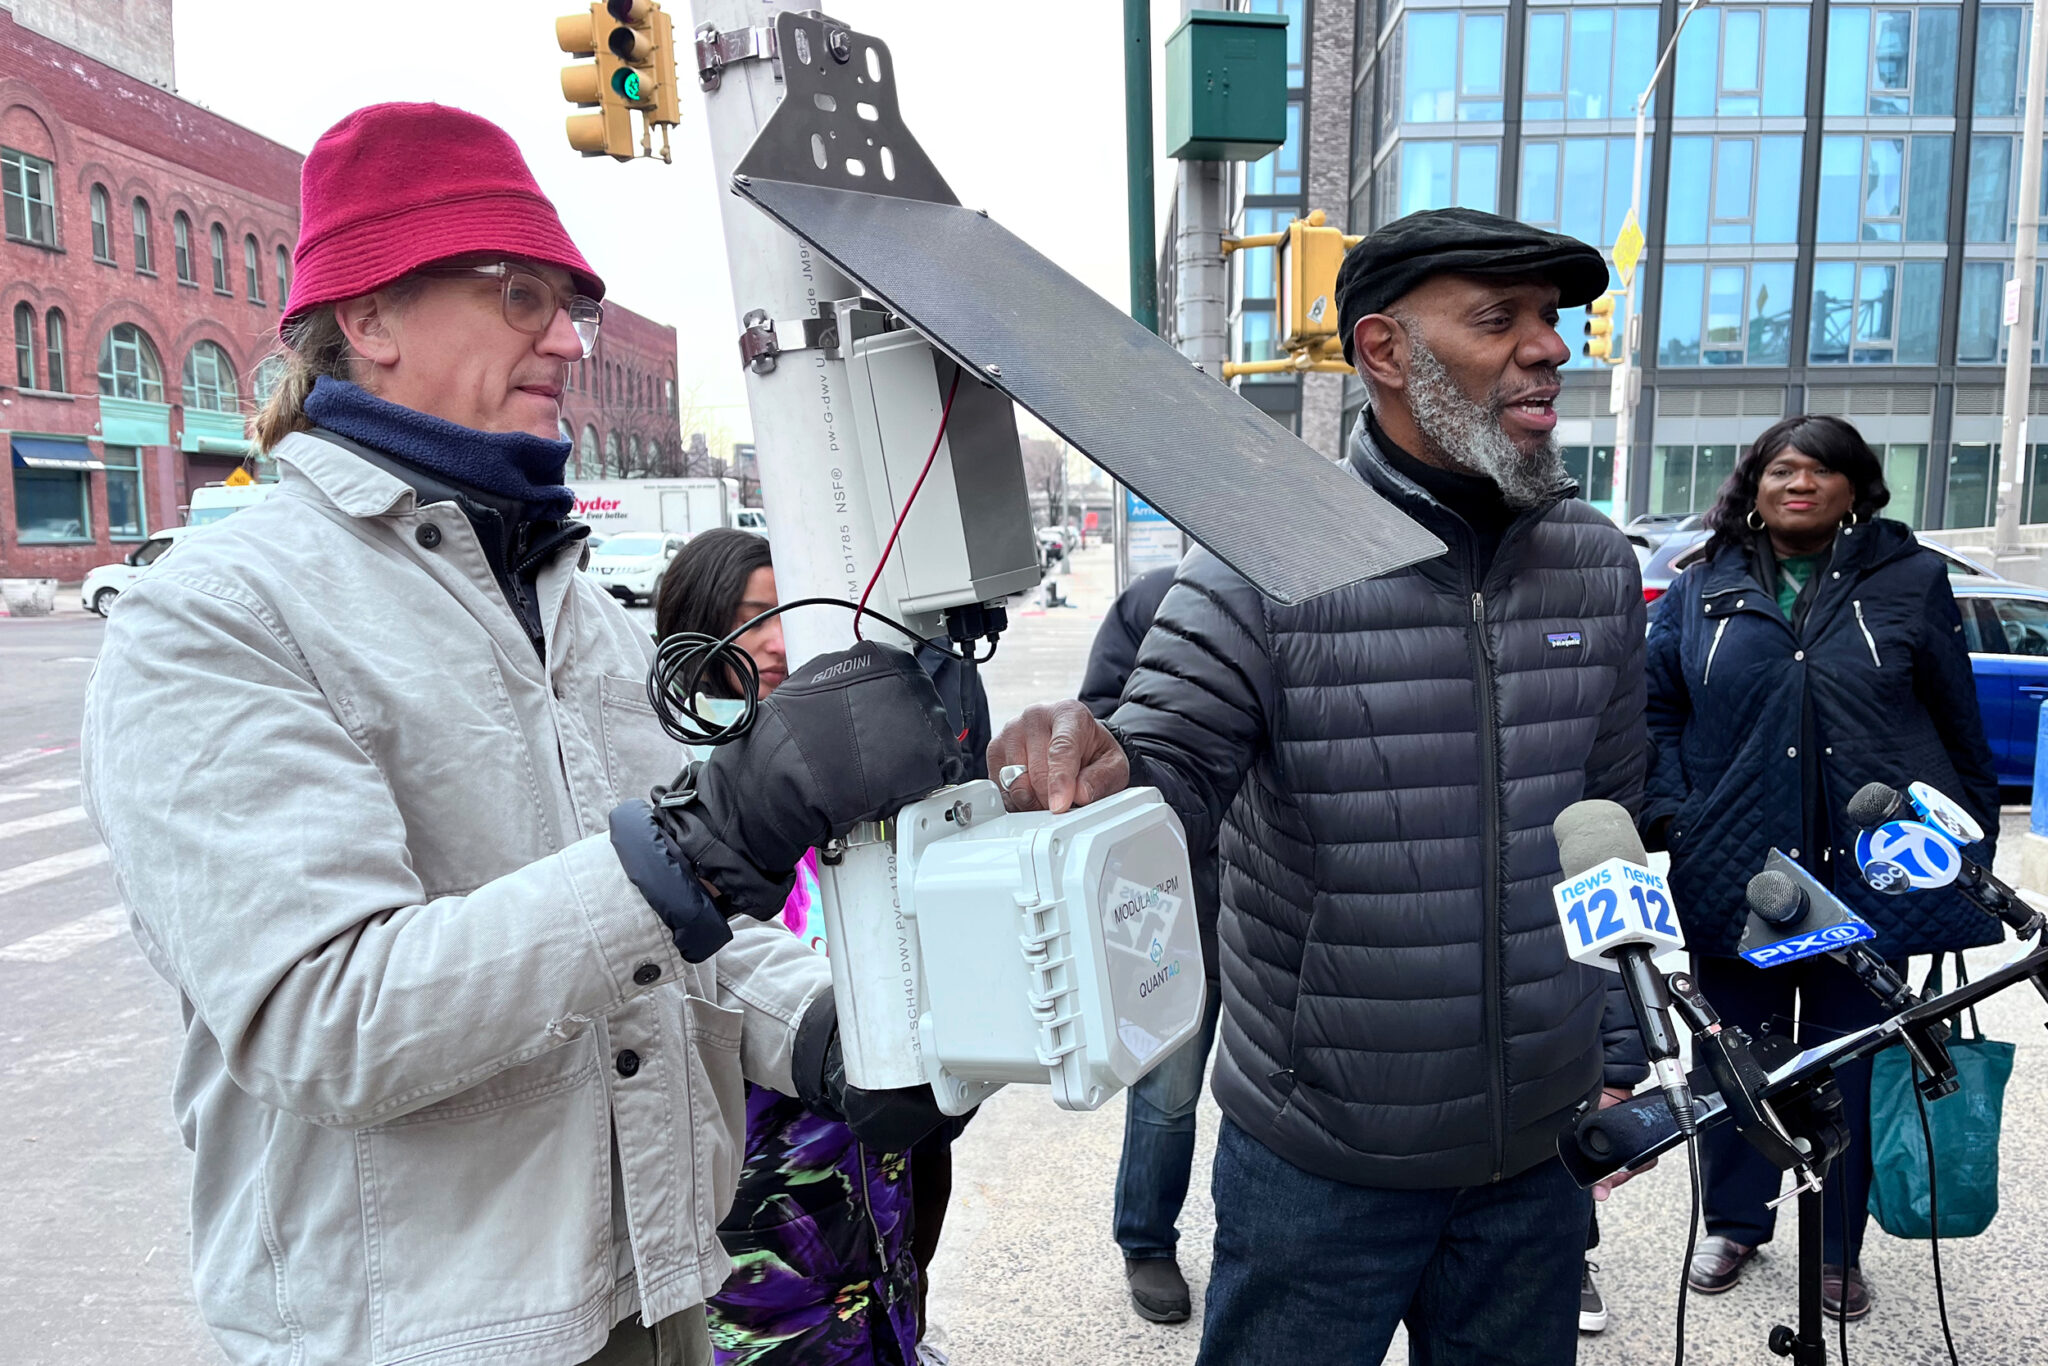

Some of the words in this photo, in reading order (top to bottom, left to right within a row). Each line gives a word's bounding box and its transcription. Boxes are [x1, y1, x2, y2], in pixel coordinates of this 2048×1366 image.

[840, 525, 855, 574] D1785
[810, 654, 871, 684] GORDINI
[1561, 868, 1612, 903] news
[1623, 865, 1664, 890] news
[1869, 866, 1904, 891] abc
[1567, 888, 1626, 947] 12
[1629, 884, 1678, 937] 12
[898, 936, 911, 973] DWV
[1749, 934, 1828, 962] PIX
[1139, 960, 1180, 998] QUANTAQ
[904, 978, 919, 1030] SCH40
